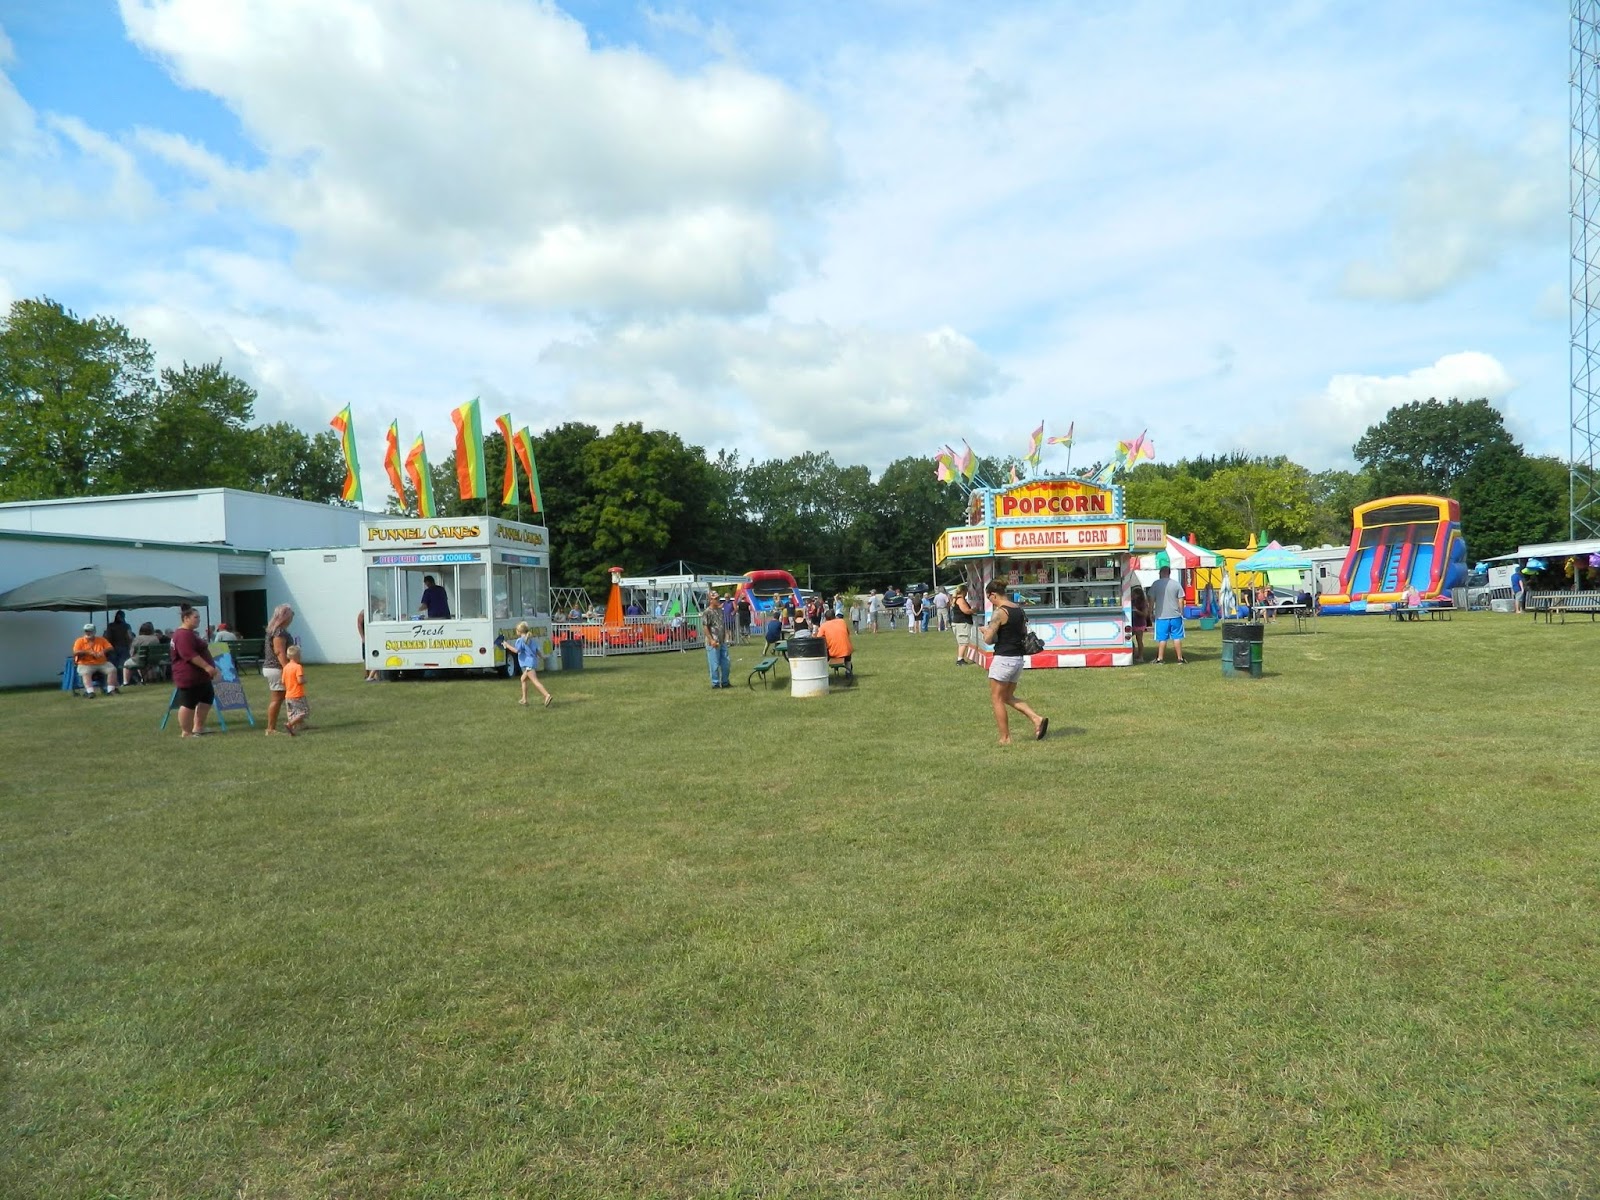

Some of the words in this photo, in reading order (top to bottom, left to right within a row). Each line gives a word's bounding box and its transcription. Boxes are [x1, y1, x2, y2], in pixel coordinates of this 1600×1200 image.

[1002, 494, 1105, 516] POPCORN
[368, 527, 427, 542] FUNNEL
[428, 525, 481, 540] CAKES
[1014, 531, 1069, 545] CARAMEL
[1078, 530, 1108, 543] CORN
[420, 554, 445, 562] OREO
[446, 553, 472, 561] COOKIES
[412, 624, 445, 638] Fresh
[428, 638, 473, 650] LEMONADE
